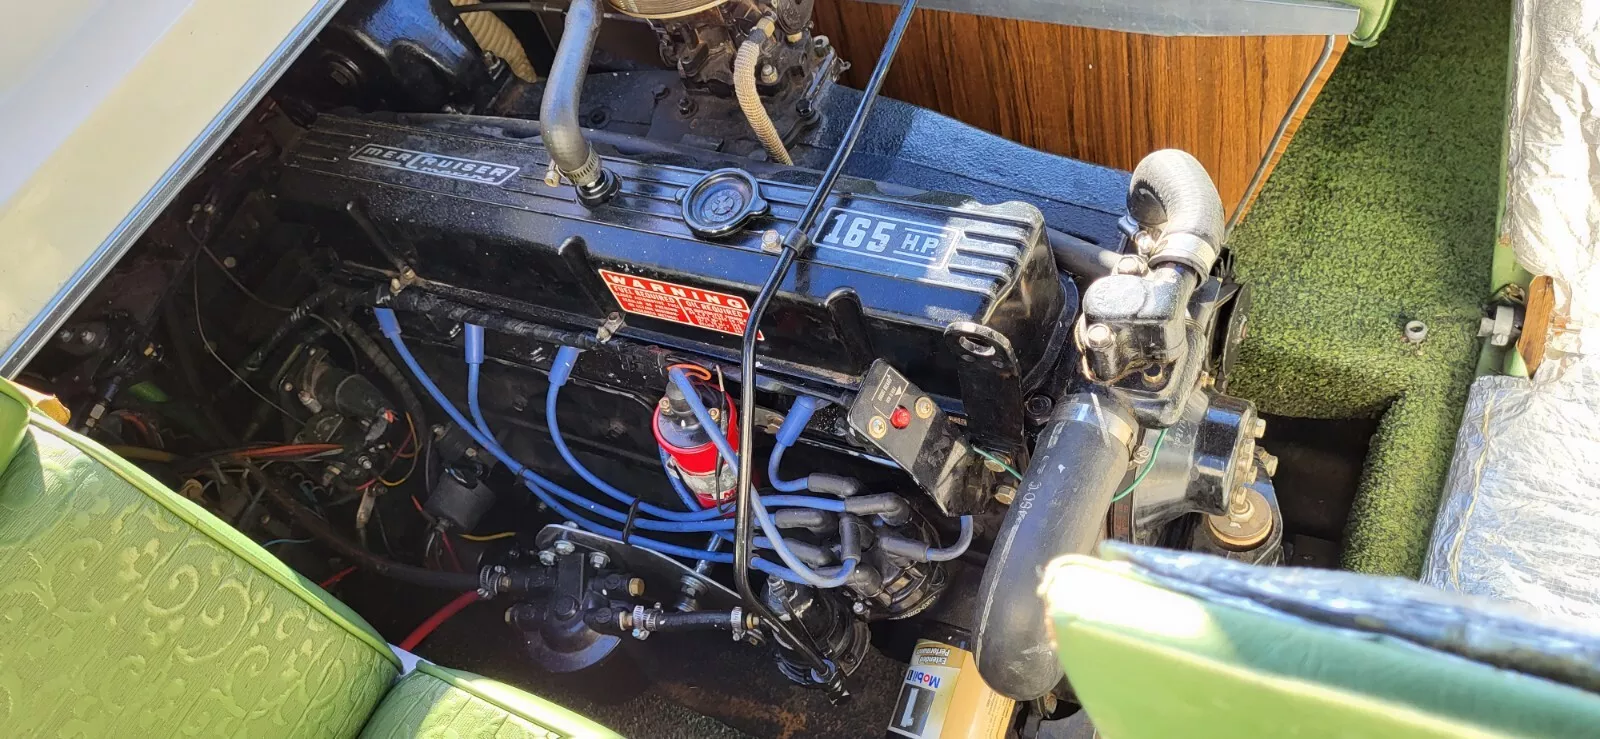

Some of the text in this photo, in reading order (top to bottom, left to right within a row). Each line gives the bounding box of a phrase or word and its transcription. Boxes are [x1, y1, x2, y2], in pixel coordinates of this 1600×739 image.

[823, 214, 897, 253] 165
[607, 274, 743, 309] WARNING
[613, 285, 634, 295] FUEL
[634, 289, 676, 303] REQUIRED
[685, 300, 700, 309] OIL
[701, 304, 743, 318] REQUIRED
[900, 687, 919, 728] 1
